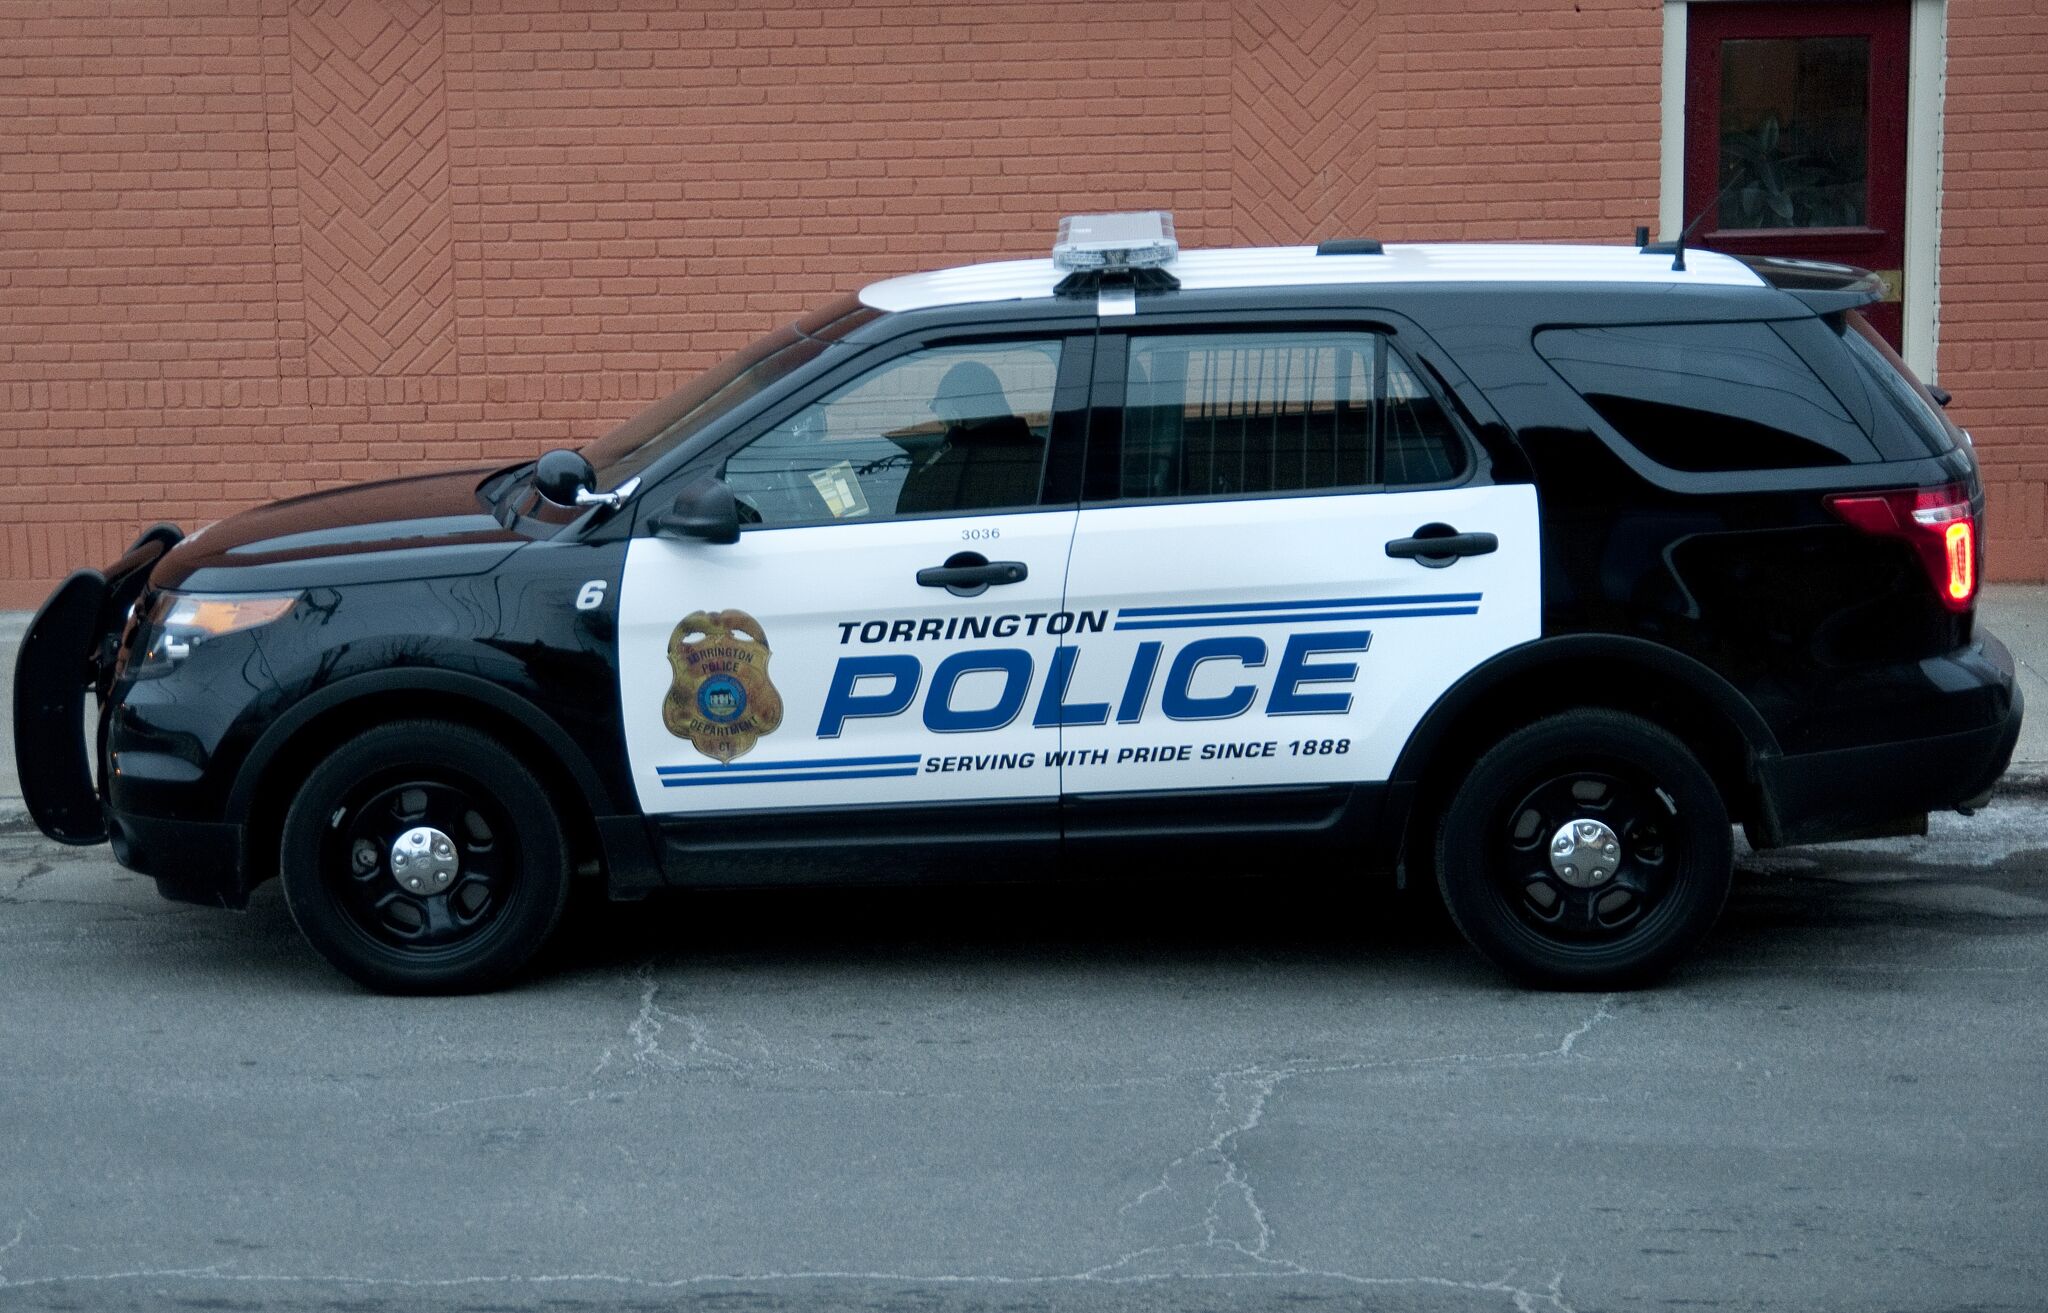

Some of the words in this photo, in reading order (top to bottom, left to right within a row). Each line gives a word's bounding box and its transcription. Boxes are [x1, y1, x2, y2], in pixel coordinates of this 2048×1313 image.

[961, 528, 1000, 540] 3036
[575, 579, 607, 611] 6
[838, 609, 1109, 645] TORRINGTON
[701, 661, 739, 674] POLICE
[815, 630, 1374, 740] POLICE
[689, 715, 758, 736] DEPARTMENT
[719, 741, 730, 752] CT
[924, 752, 1036, 773] SERVING
[1045, 748, 1108, 768] WITH
[1116, 745, 1193, 764] PRIDE
[1200, 741, 1278, 760] SINCE
[1288, 738, 1351, 757] 1888
